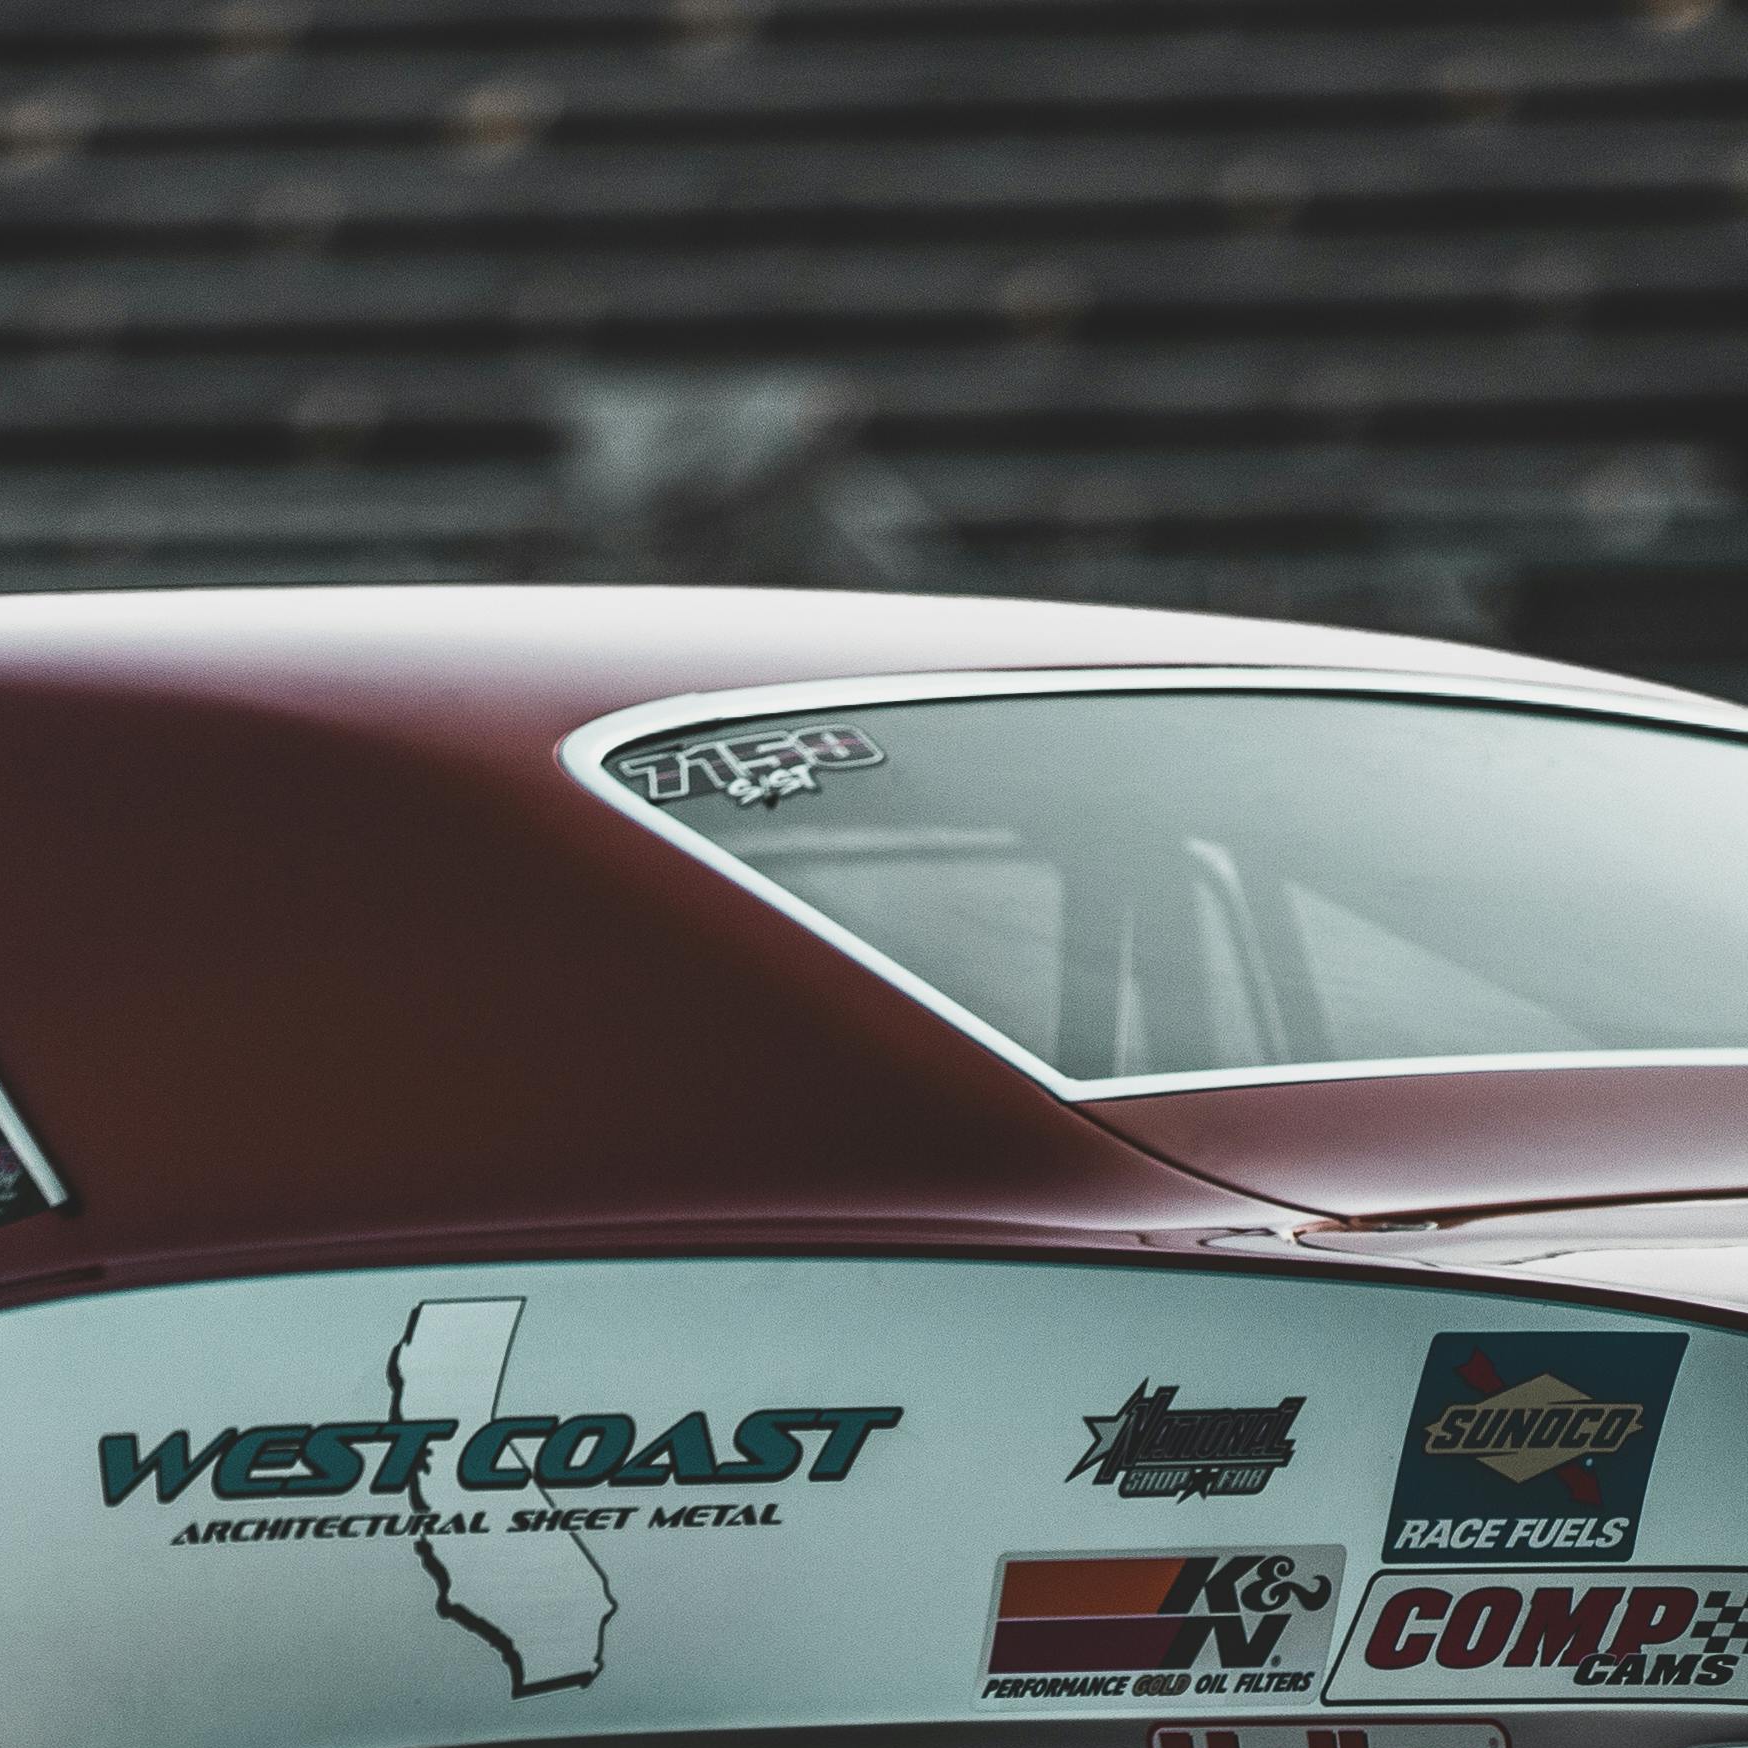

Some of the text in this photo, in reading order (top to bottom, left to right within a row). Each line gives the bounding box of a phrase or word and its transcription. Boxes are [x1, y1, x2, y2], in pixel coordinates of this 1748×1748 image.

[1428, 1406, 1640, 1452] SUNOCO
[98, 1406, 905, 1507] WEST COAST
[170, 1502, 783, 1546] ARCHITECTURAL SHEET METAL
[1394, 1516, 1631, 1550] RACE FUELS
[1156, 1554, 1333, 1670] K&N
[1363, 1585, 1740, 1687] COMP CAMS
[981, 1672, 1316, 1699] PERFORMANCE GOLD OIL FILTERS
